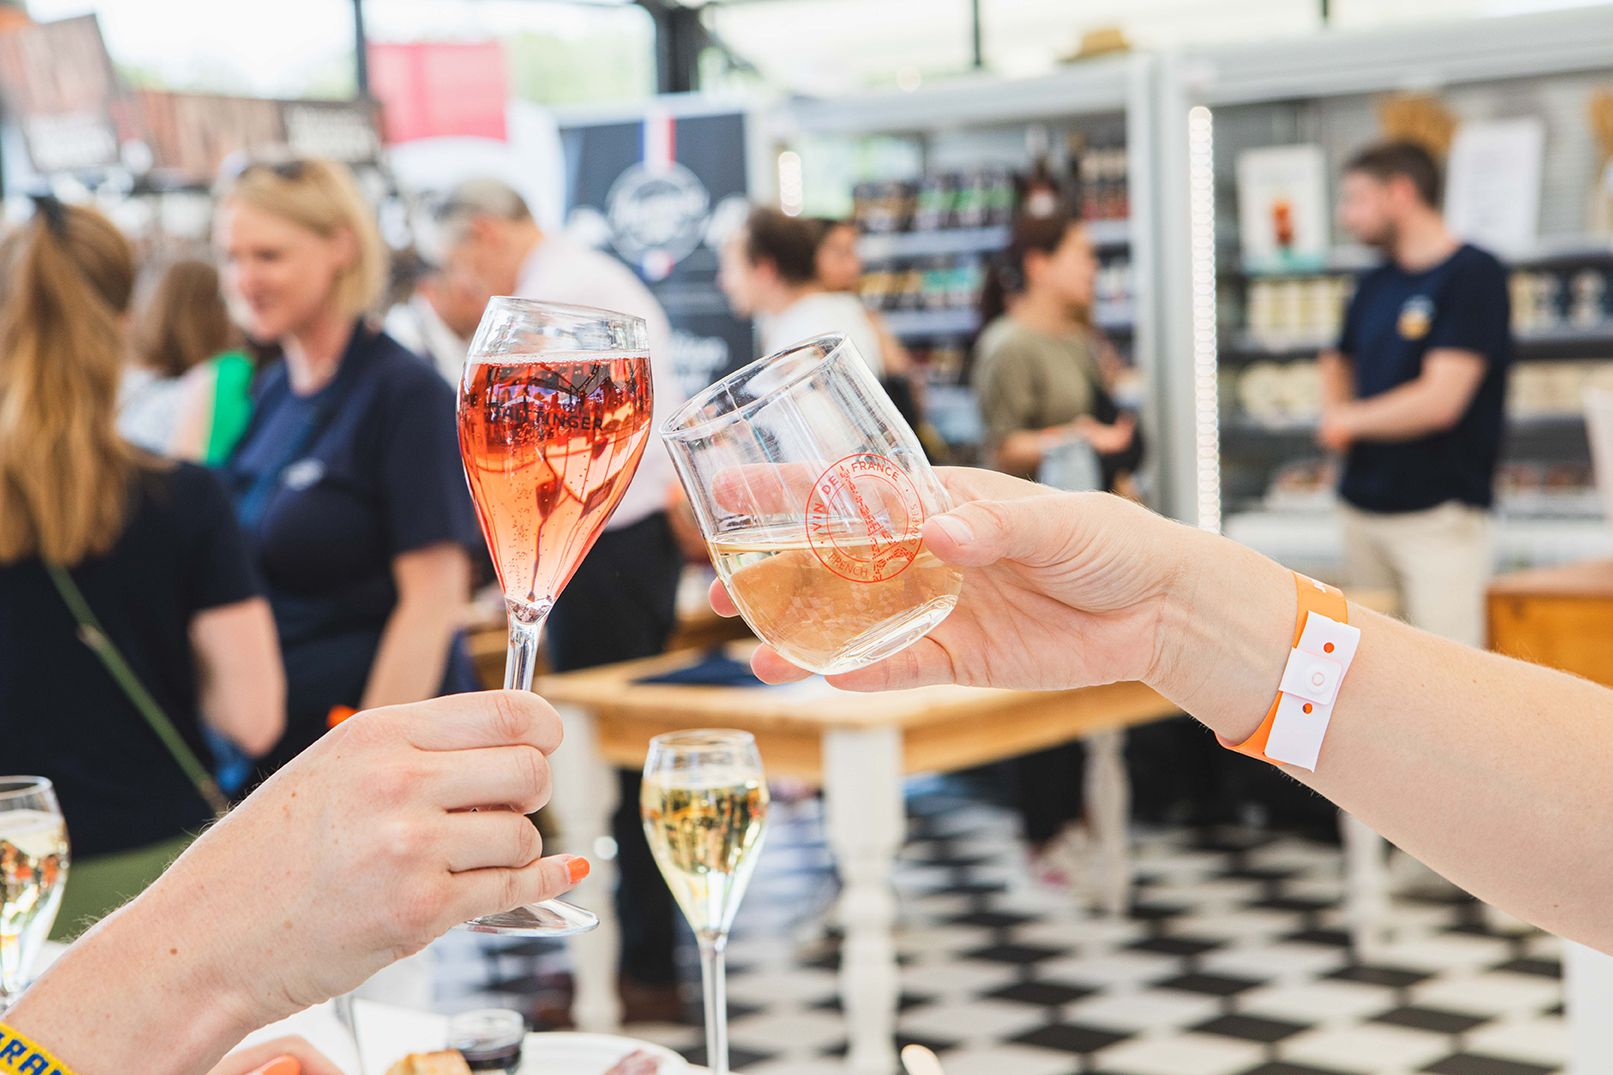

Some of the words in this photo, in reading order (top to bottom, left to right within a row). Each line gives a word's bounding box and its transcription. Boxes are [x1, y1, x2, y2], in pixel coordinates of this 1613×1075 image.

[491, 403, 603, 431] TAITTINGER
[812, 502, 825, 532] VIN
[821, 475, 839, 495] DE
[851, 460, 900, 482] FRANCE
[828, 552, 869, 577] FRENCH
[908, 503, 921, 546] GRAPES
